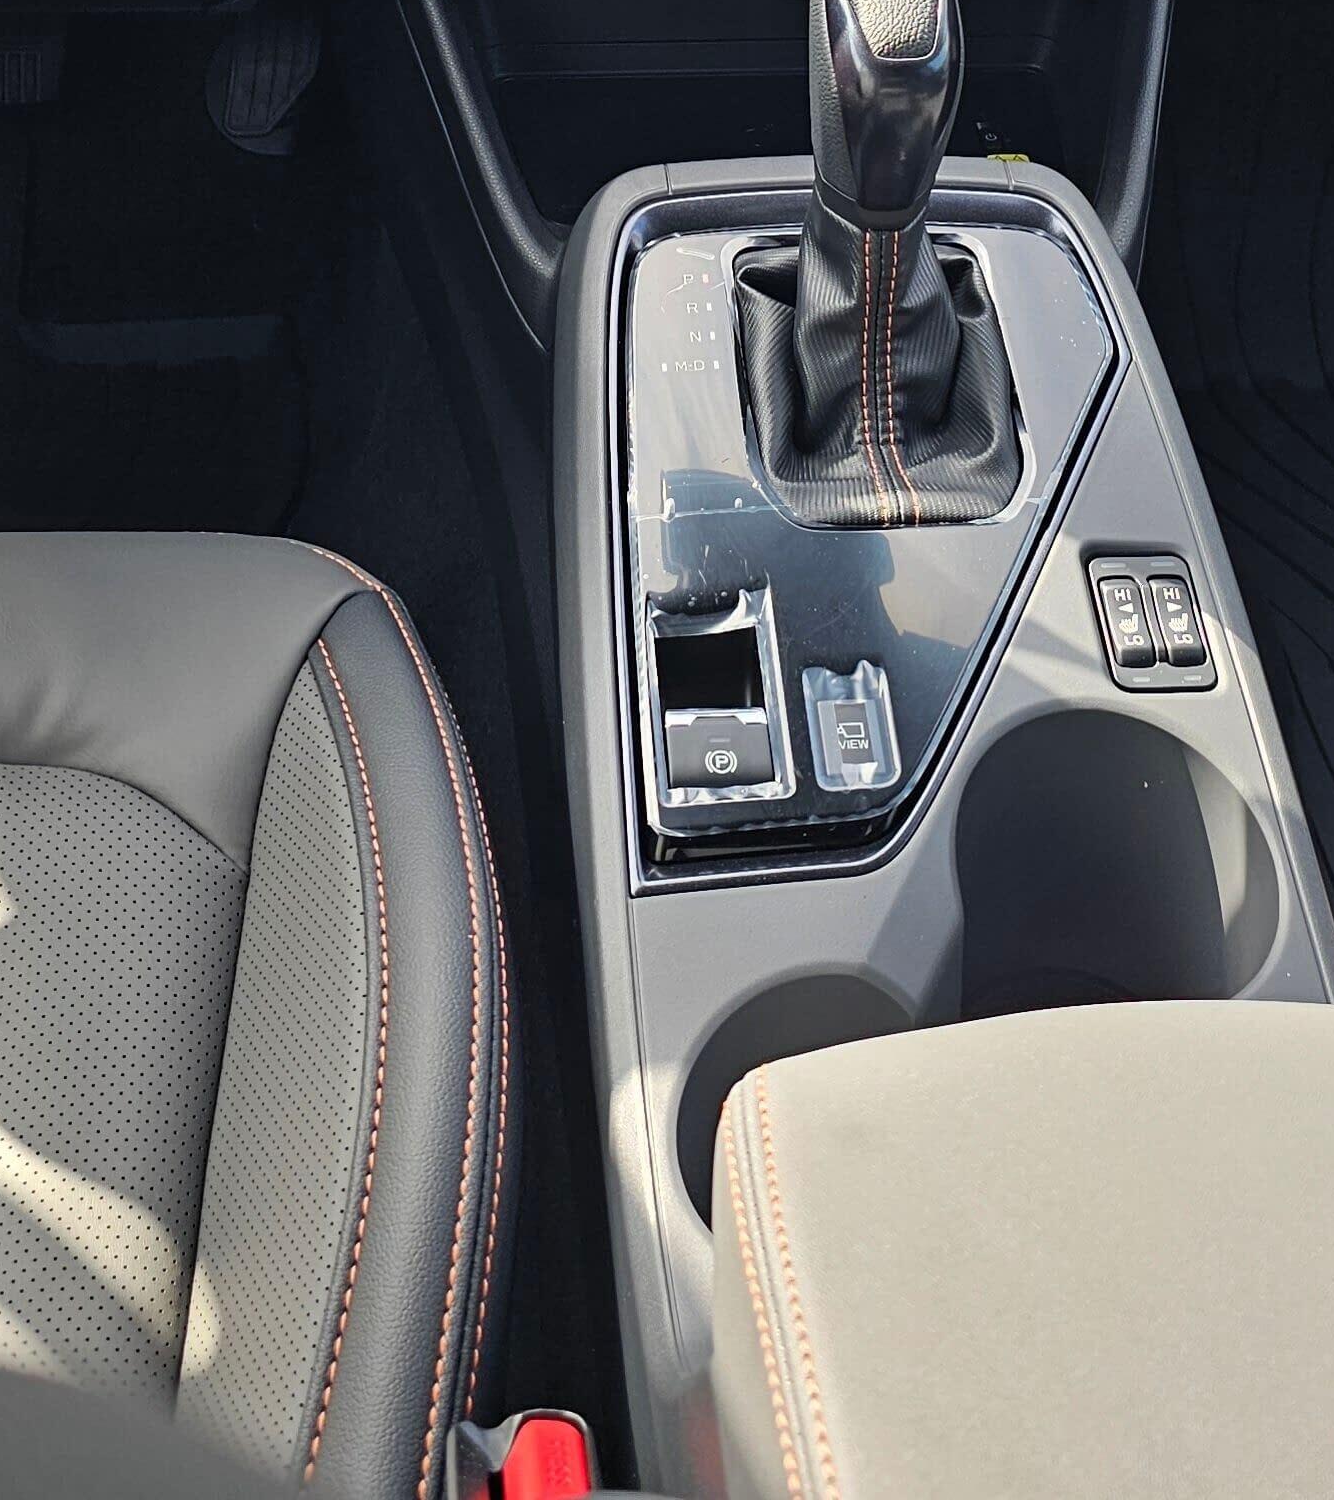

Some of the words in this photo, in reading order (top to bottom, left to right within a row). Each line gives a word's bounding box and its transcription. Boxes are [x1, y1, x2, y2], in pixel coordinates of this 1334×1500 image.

[683, 274, 694, 285] P
[686, 303, 699, 314] R
[690, 331, 702, 343] N
[1114, 587, 1132, 602] HI
[1163, 587, 1181, 600] HI
[1123, 634, 1145, 646] LO
[1174, 633, 1194, 645] LO
[838, 739, 869, 750] VIEW
